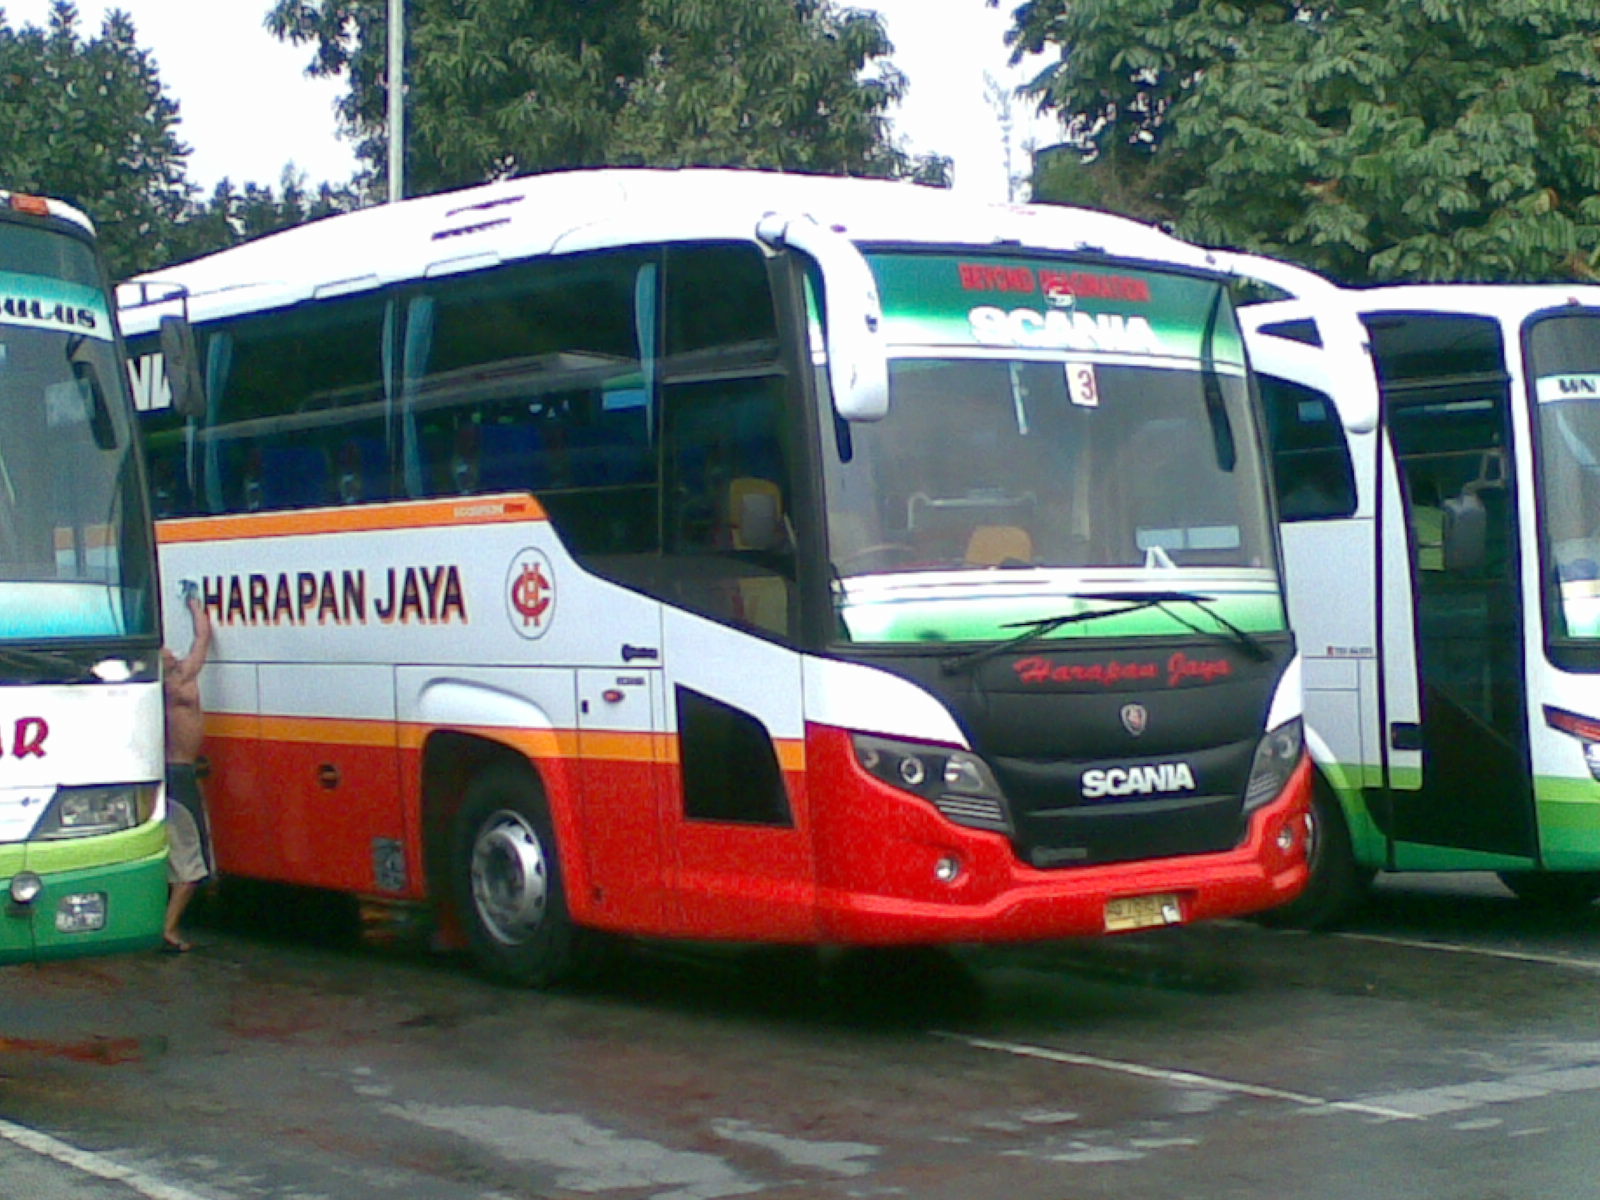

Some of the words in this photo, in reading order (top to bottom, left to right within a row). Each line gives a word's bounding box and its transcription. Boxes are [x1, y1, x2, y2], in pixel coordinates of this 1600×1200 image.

[967, 305, 1157, 352] SCANIA
[1076, 370, 1094, 400] 3
[202, 569, 367, 626] HARAPAN
[374, 565, 468, 625] JAYA
[1013, 655, 1158, 687] Harapan
[1167, 652, 1233, 687] Jaya
[1081, 762, 1195, 798] SCANIA
